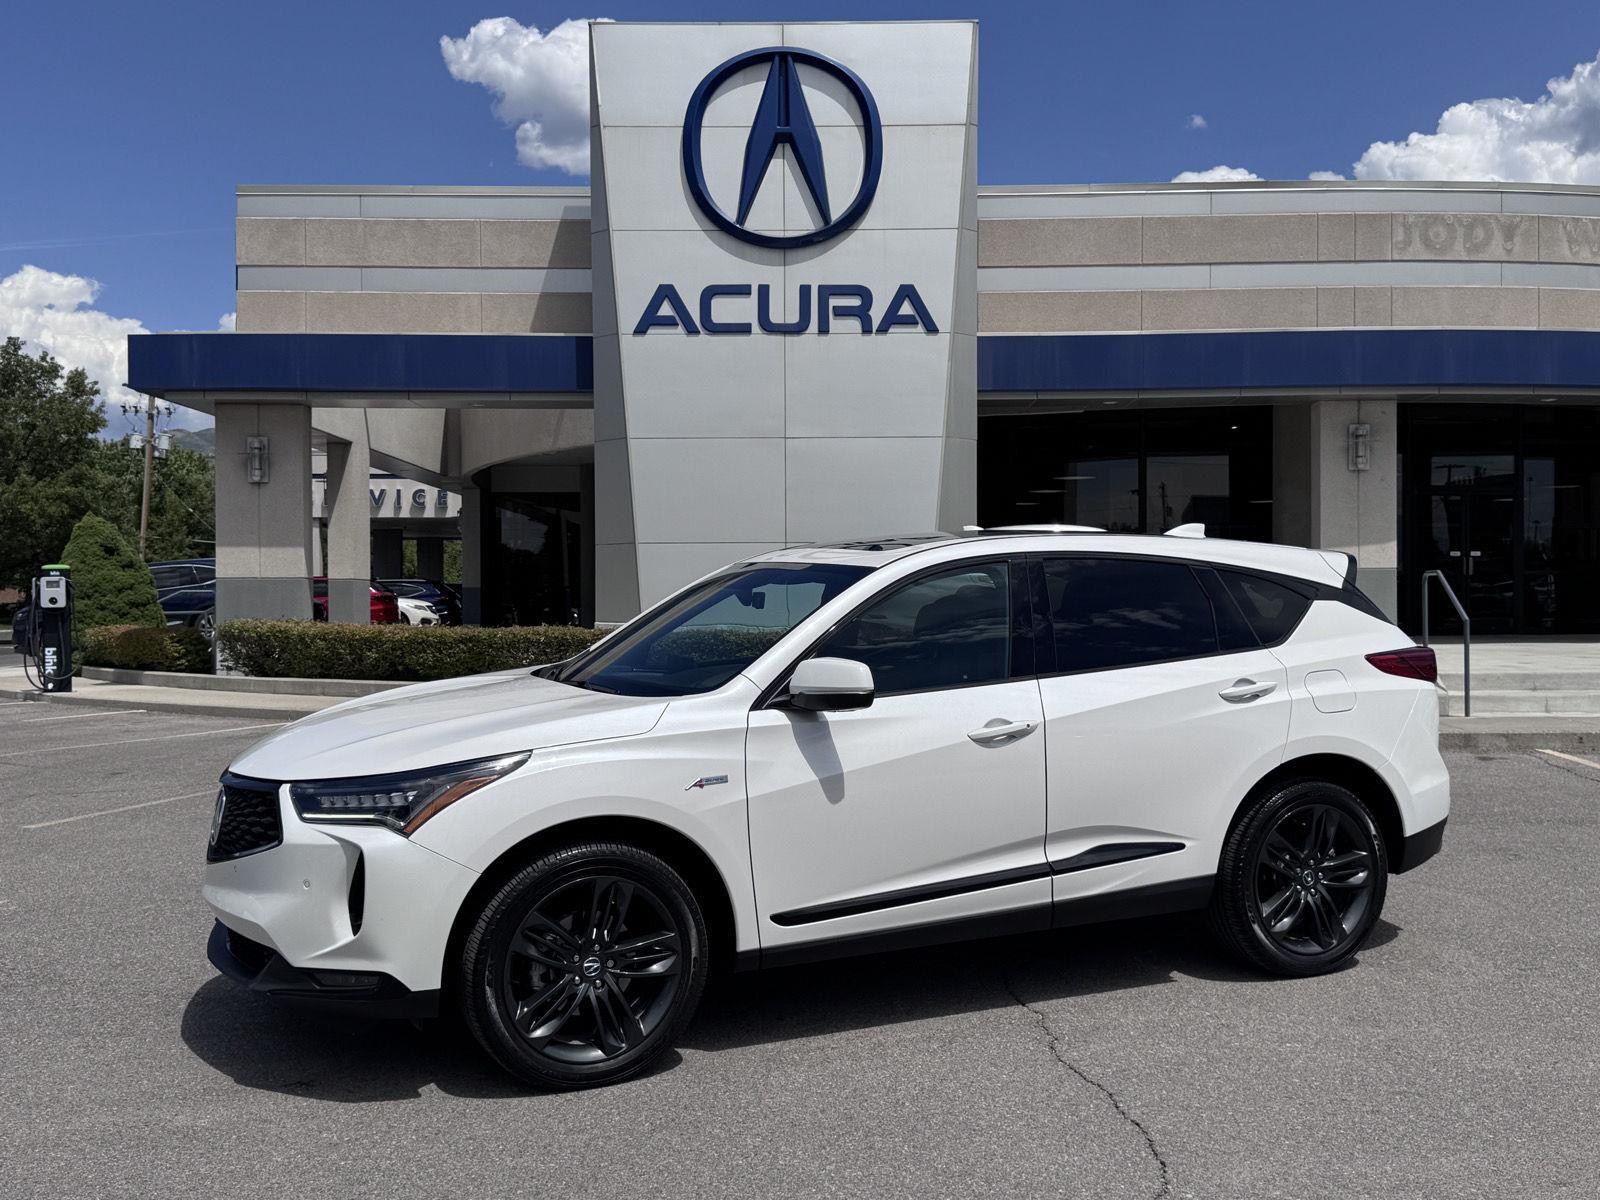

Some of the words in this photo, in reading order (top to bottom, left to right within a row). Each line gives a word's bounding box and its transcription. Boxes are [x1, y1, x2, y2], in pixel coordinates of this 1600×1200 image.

[633, 284, 939, 335] ACURA
[369, 488, 448, 507] VICE
[44, 647, 58, 675] blink
